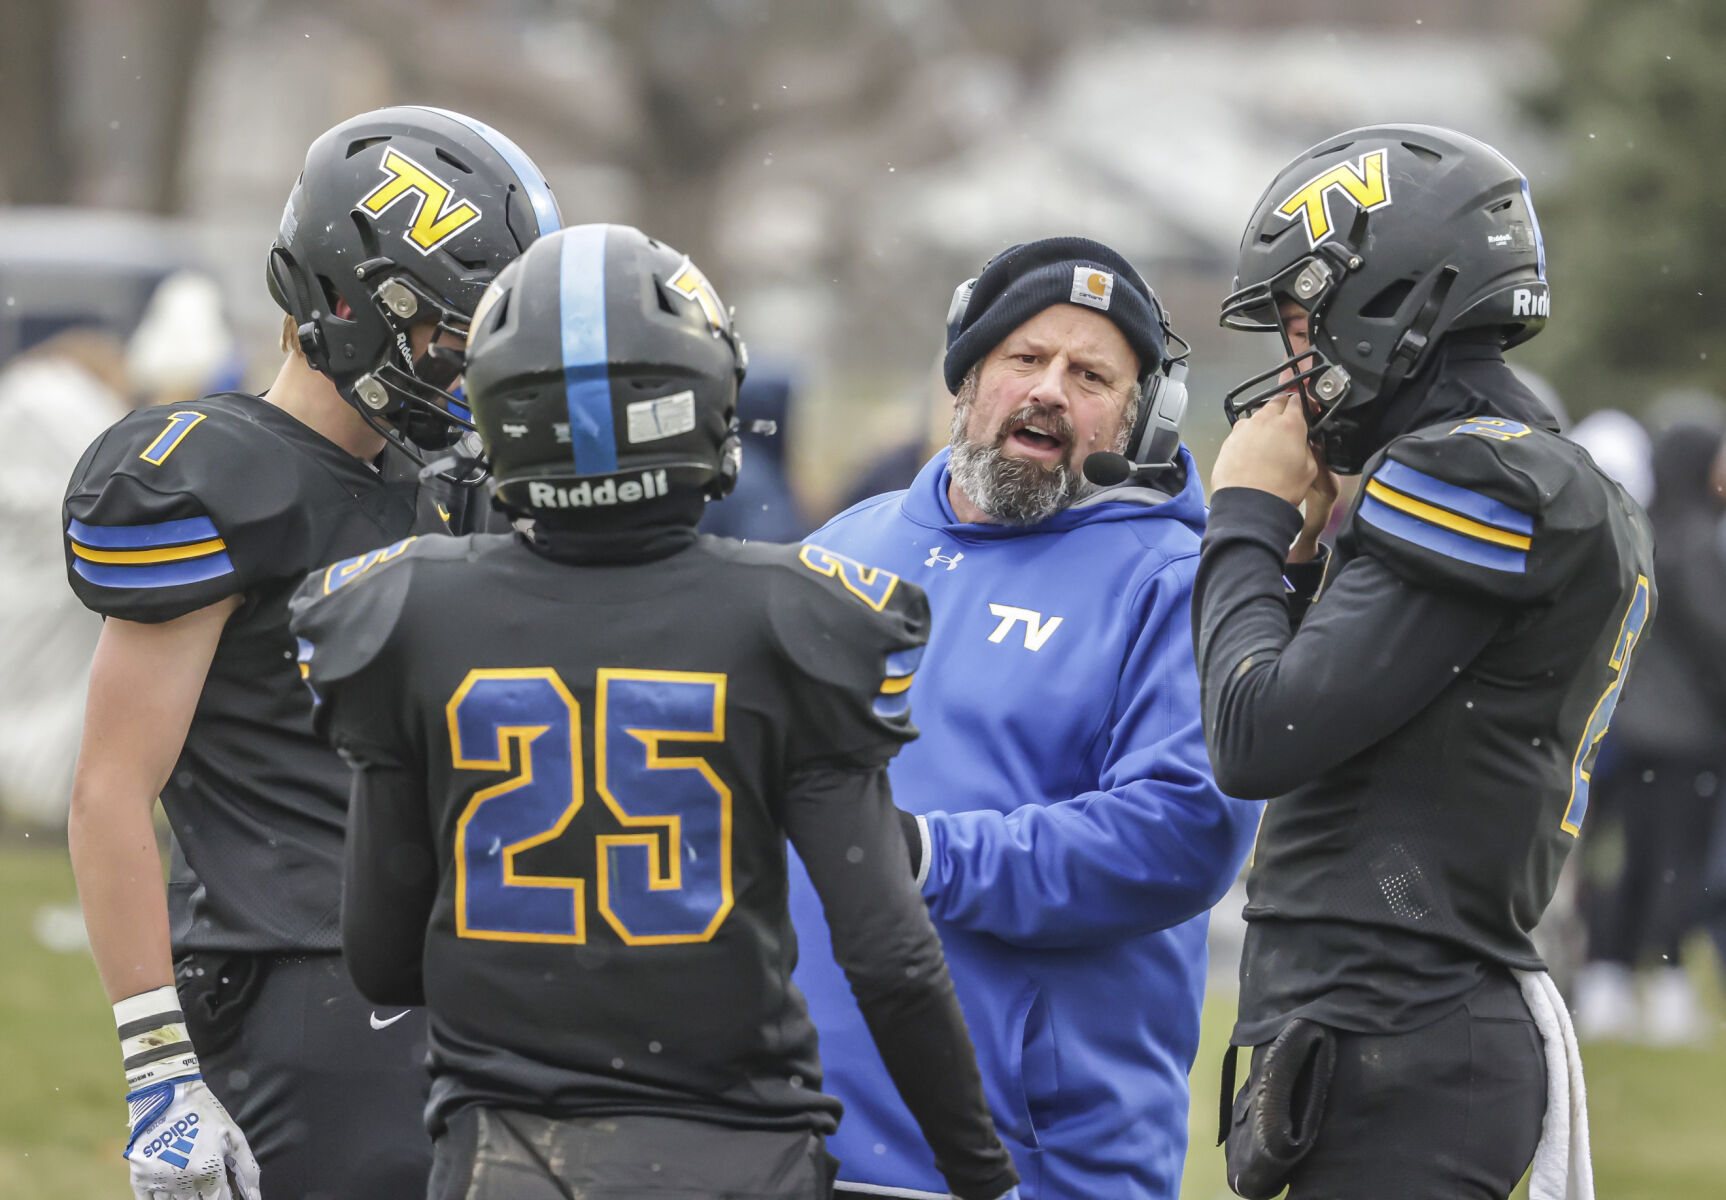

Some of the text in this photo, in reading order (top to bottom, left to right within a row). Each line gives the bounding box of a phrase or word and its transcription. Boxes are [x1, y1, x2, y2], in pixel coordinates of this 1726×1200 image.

[356, 145, 482, 256] TV
[1273, 148, 1393, 250] TV
[1512, 288, 1551, 318] Rid
[139, 410, 208, 467] 1
[529, 470, 668, 509] Riddell
[987, 603, 1065, 652] TV
[446, 667, 734, 947] 25
[143, 1112, 200, 1158] adidas
